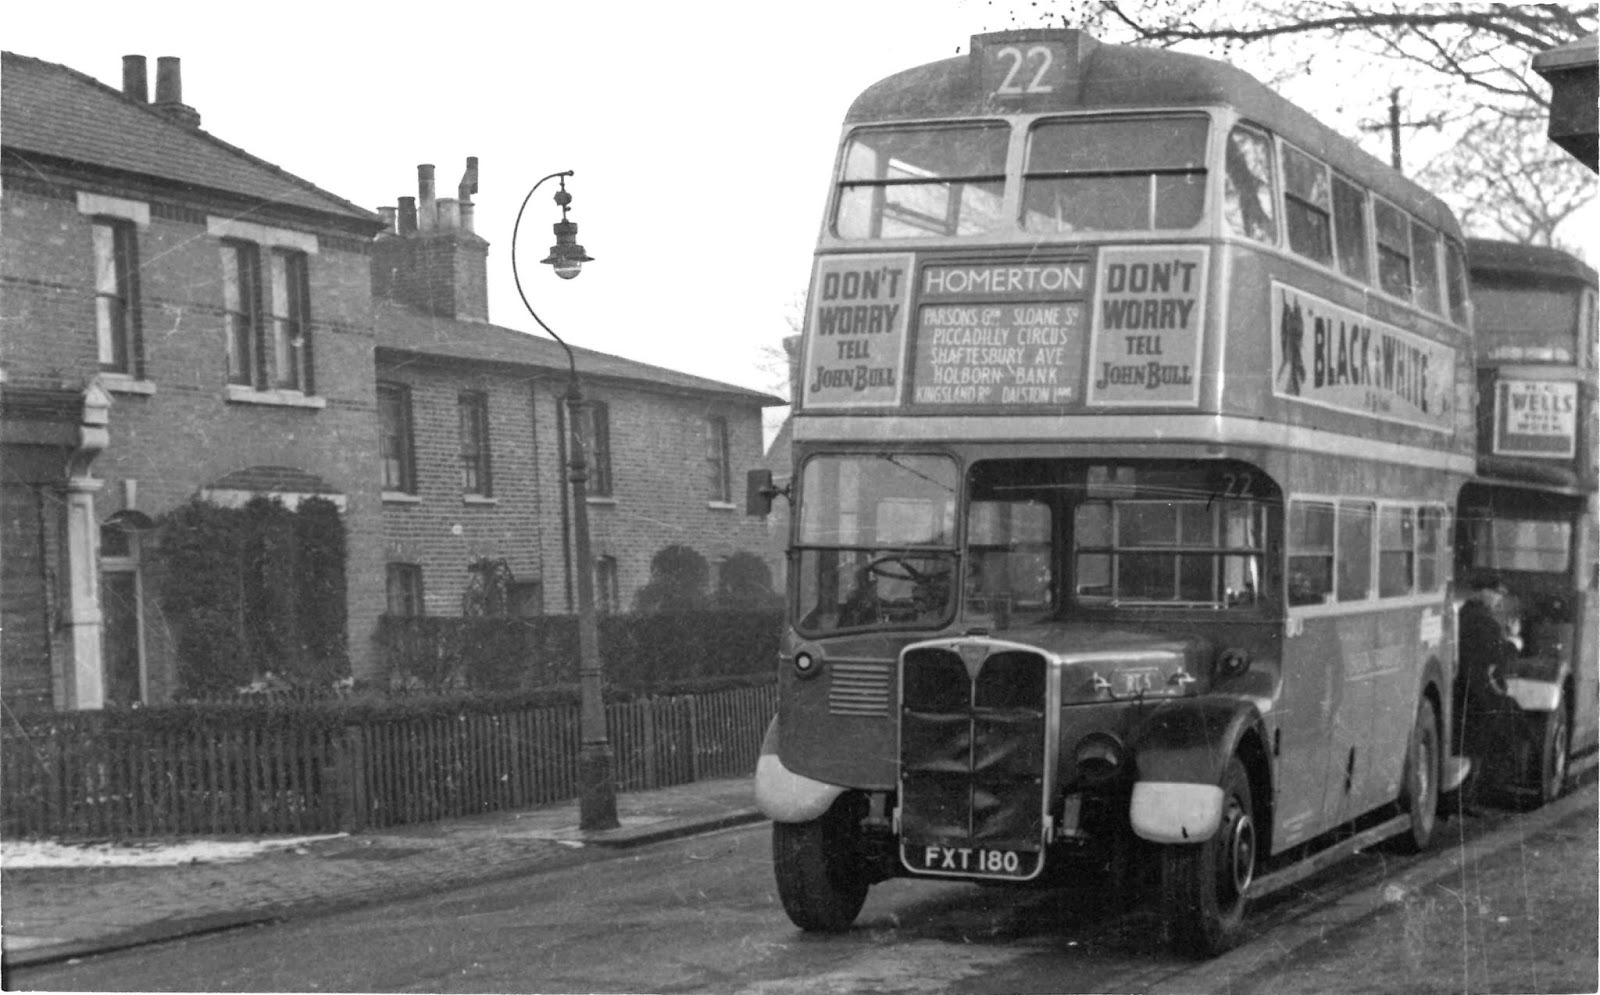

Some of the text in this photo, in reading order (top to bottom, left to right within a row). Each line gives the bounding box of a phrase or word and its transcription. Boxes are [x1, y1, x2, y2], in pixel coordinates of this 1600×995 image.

[998, 46, 1053, 94] 22
[822, 266, 903, 301] DON'T
[926, 267, 1084, 293] HOMERTON
[1107, 260, 1197, 293] DON'T
[818, 304, 899, 336] WORRY
[924, 307, 978, 326] PARSONS
[1012, 306, 1060, 326] SLOANE
[1103, 299, 1195, 330] WORRY
[837, 339, 870, 360] TELL
[932, 327, 1069, 346] PICCADILLY CIRCUS
[1125, 335, 1163, 355] TELL
[930, 347, 1065, 365] SHAFTESBURY AVE
[1313, 316, 1371, 389] BLACK
[1381, 332, 1428, 414] WHITE
[933, 366, 1058, 385] HOLBORN BANK
[1001, 386, 1050, 404] DALSTON
[1512, 393, 1572, 414] WELLS
[1222, 472, 1254, 498] 22
[925, 846, 1019, 872] FXT 180
